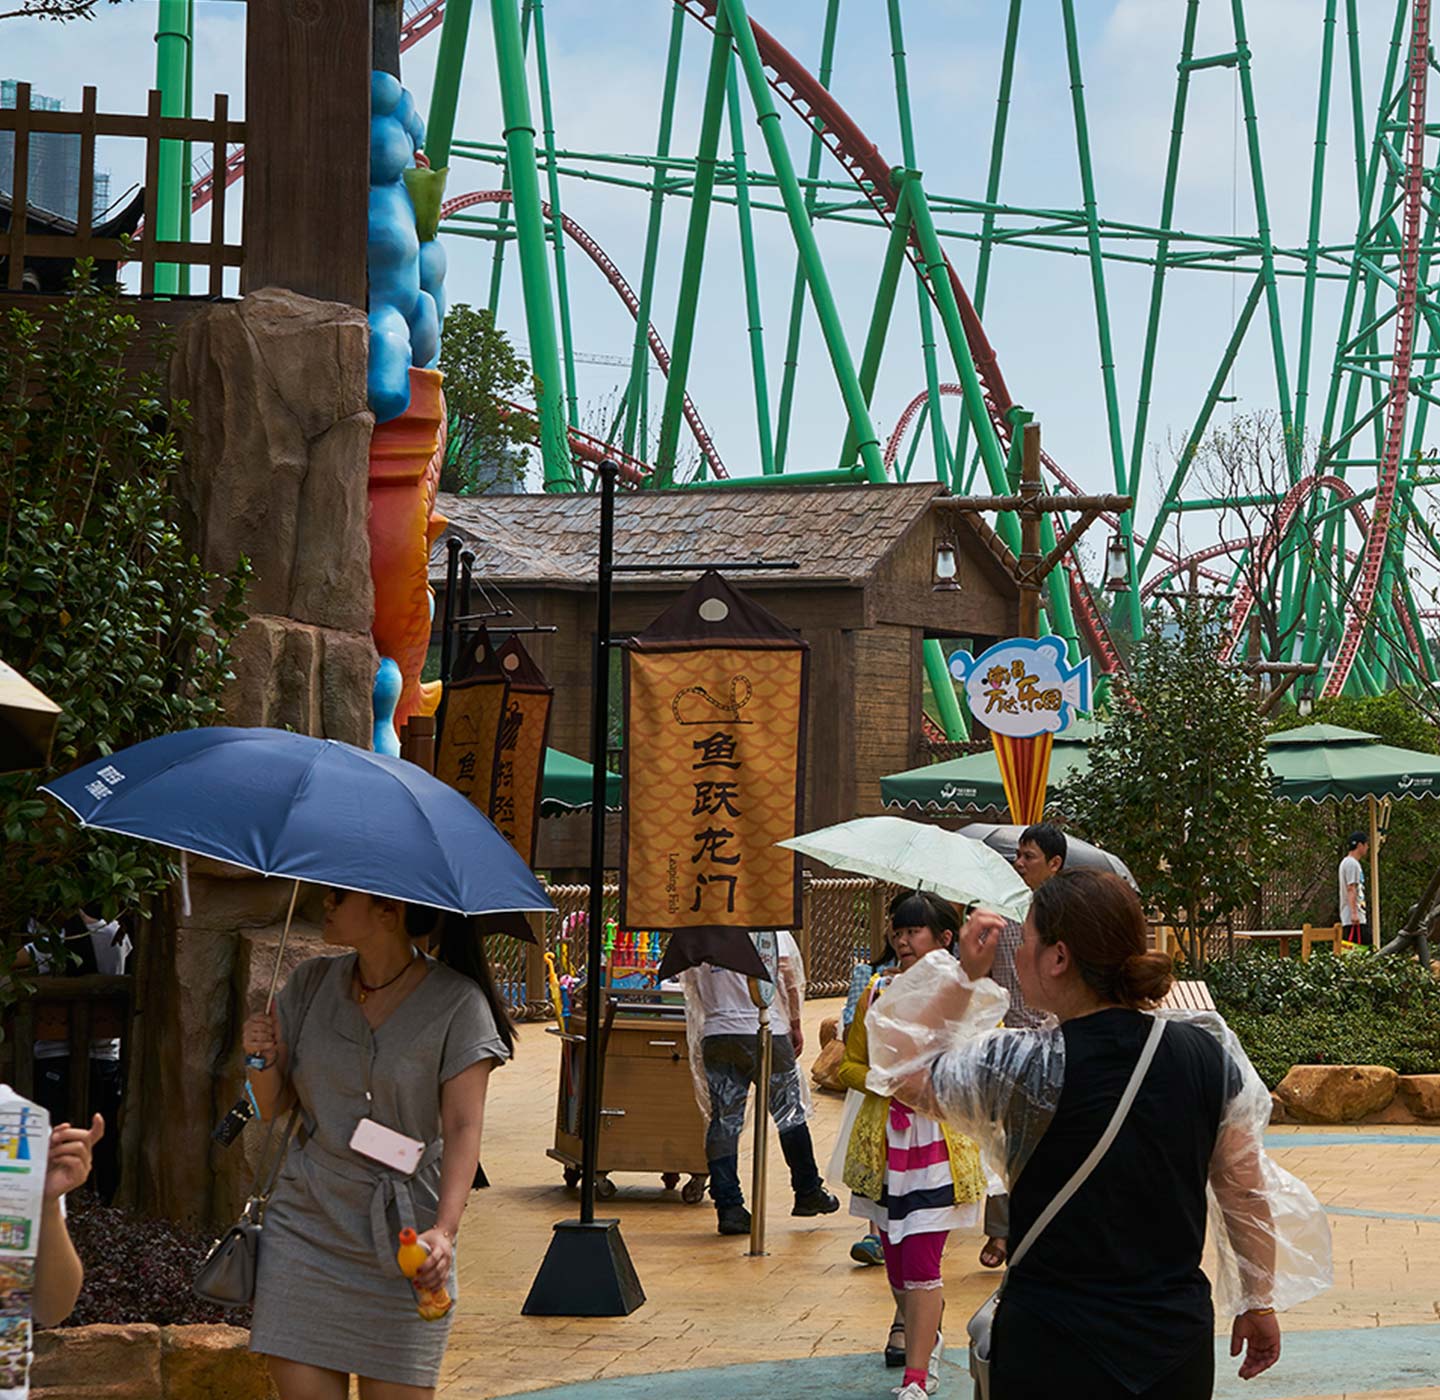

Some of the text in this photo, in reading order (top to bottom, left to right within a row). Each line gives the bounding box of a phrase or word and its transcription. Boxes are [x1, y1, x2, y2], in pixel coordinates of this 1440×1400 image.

[665, 853, 680, 892] Leaping
[689, 731, 742, 913] 鱼跃龙门
